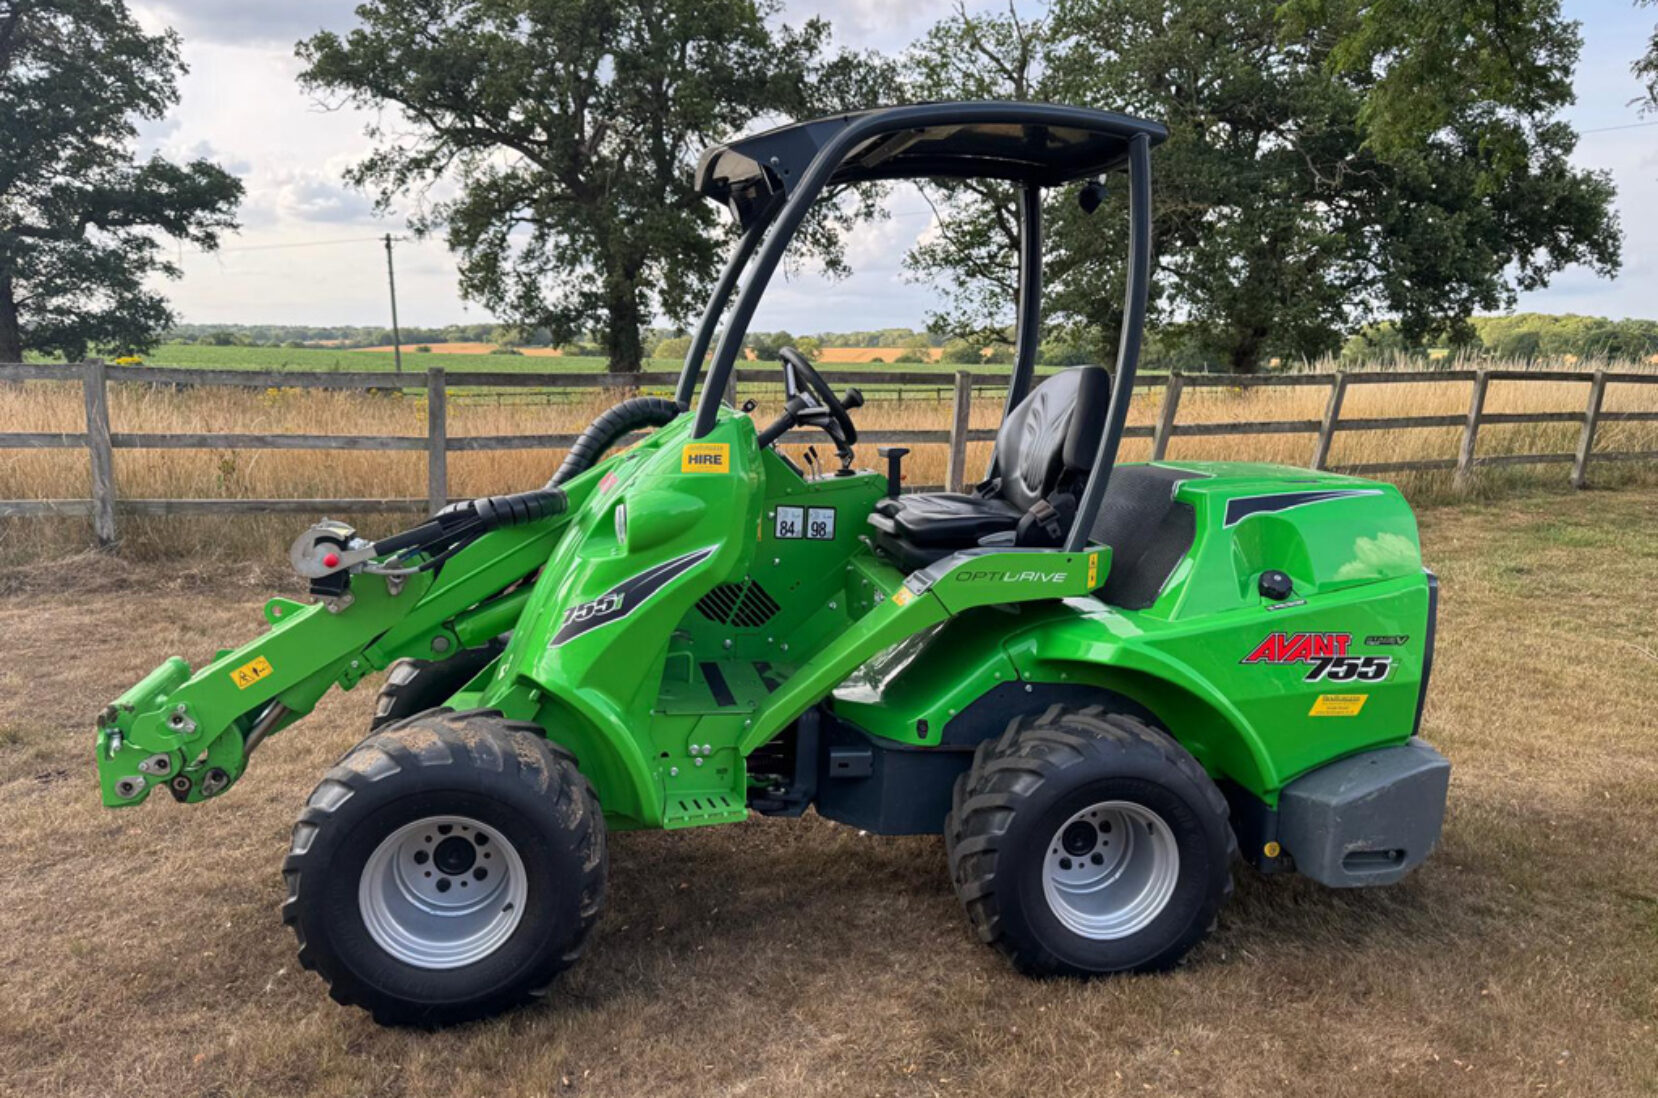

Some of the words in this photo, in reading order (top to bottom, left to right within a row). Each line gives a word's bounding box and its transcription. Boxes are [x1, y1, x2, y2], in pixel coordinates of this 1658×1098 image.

[688, 454, 723, 465] HIRE
[780, 520, 795, 536] 84
[811, 521, 827, 537] 98
[1241, 632, 1352, 664] AVANT
